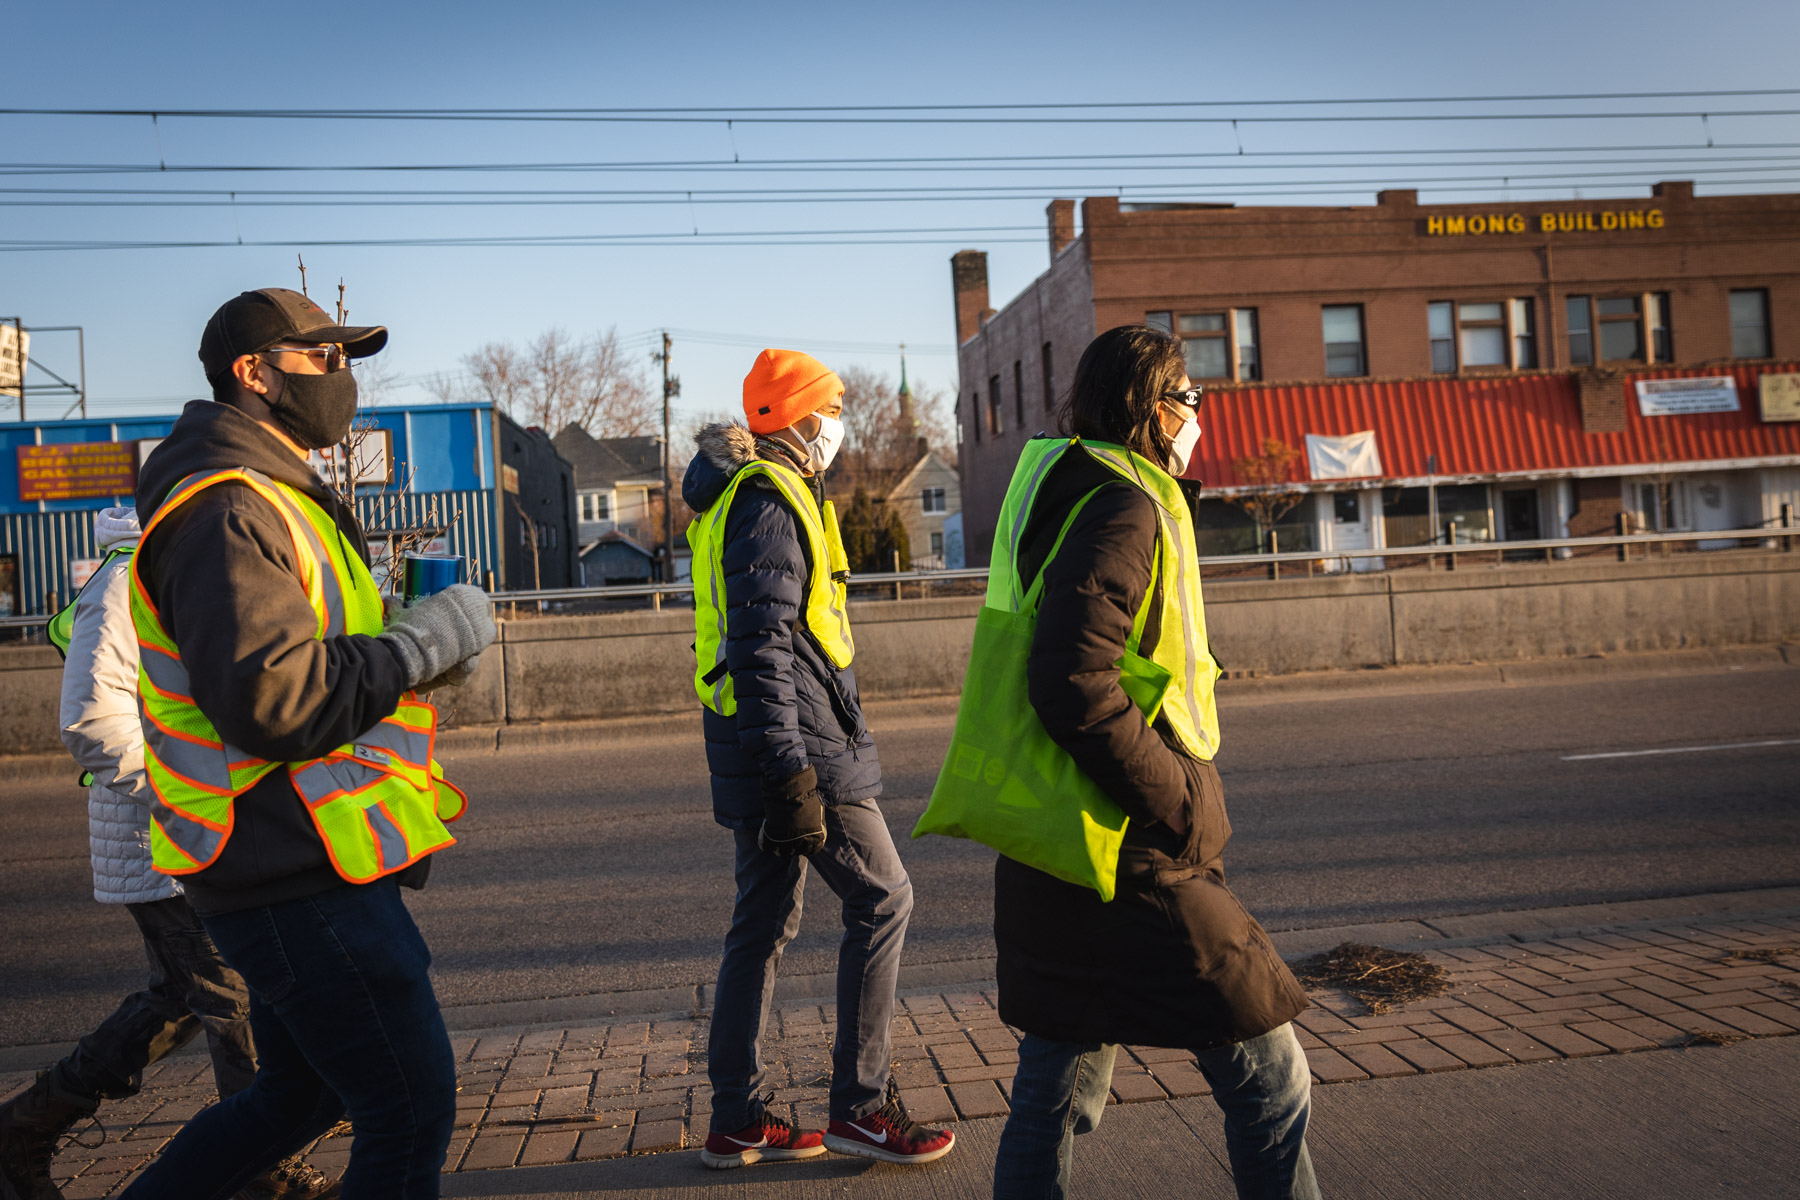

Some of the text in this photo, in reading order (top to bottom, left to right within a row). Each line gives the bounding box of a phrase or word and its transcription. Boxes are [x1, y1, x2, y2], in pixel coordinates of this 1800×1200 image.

[1428, 209, 1665, 236] HMONG BUILDING
[73, 445, 122, 454] HAIR
[22, 454, 132, 468] BRAIDING
[24, 466, 131, 479] GALLERIA
